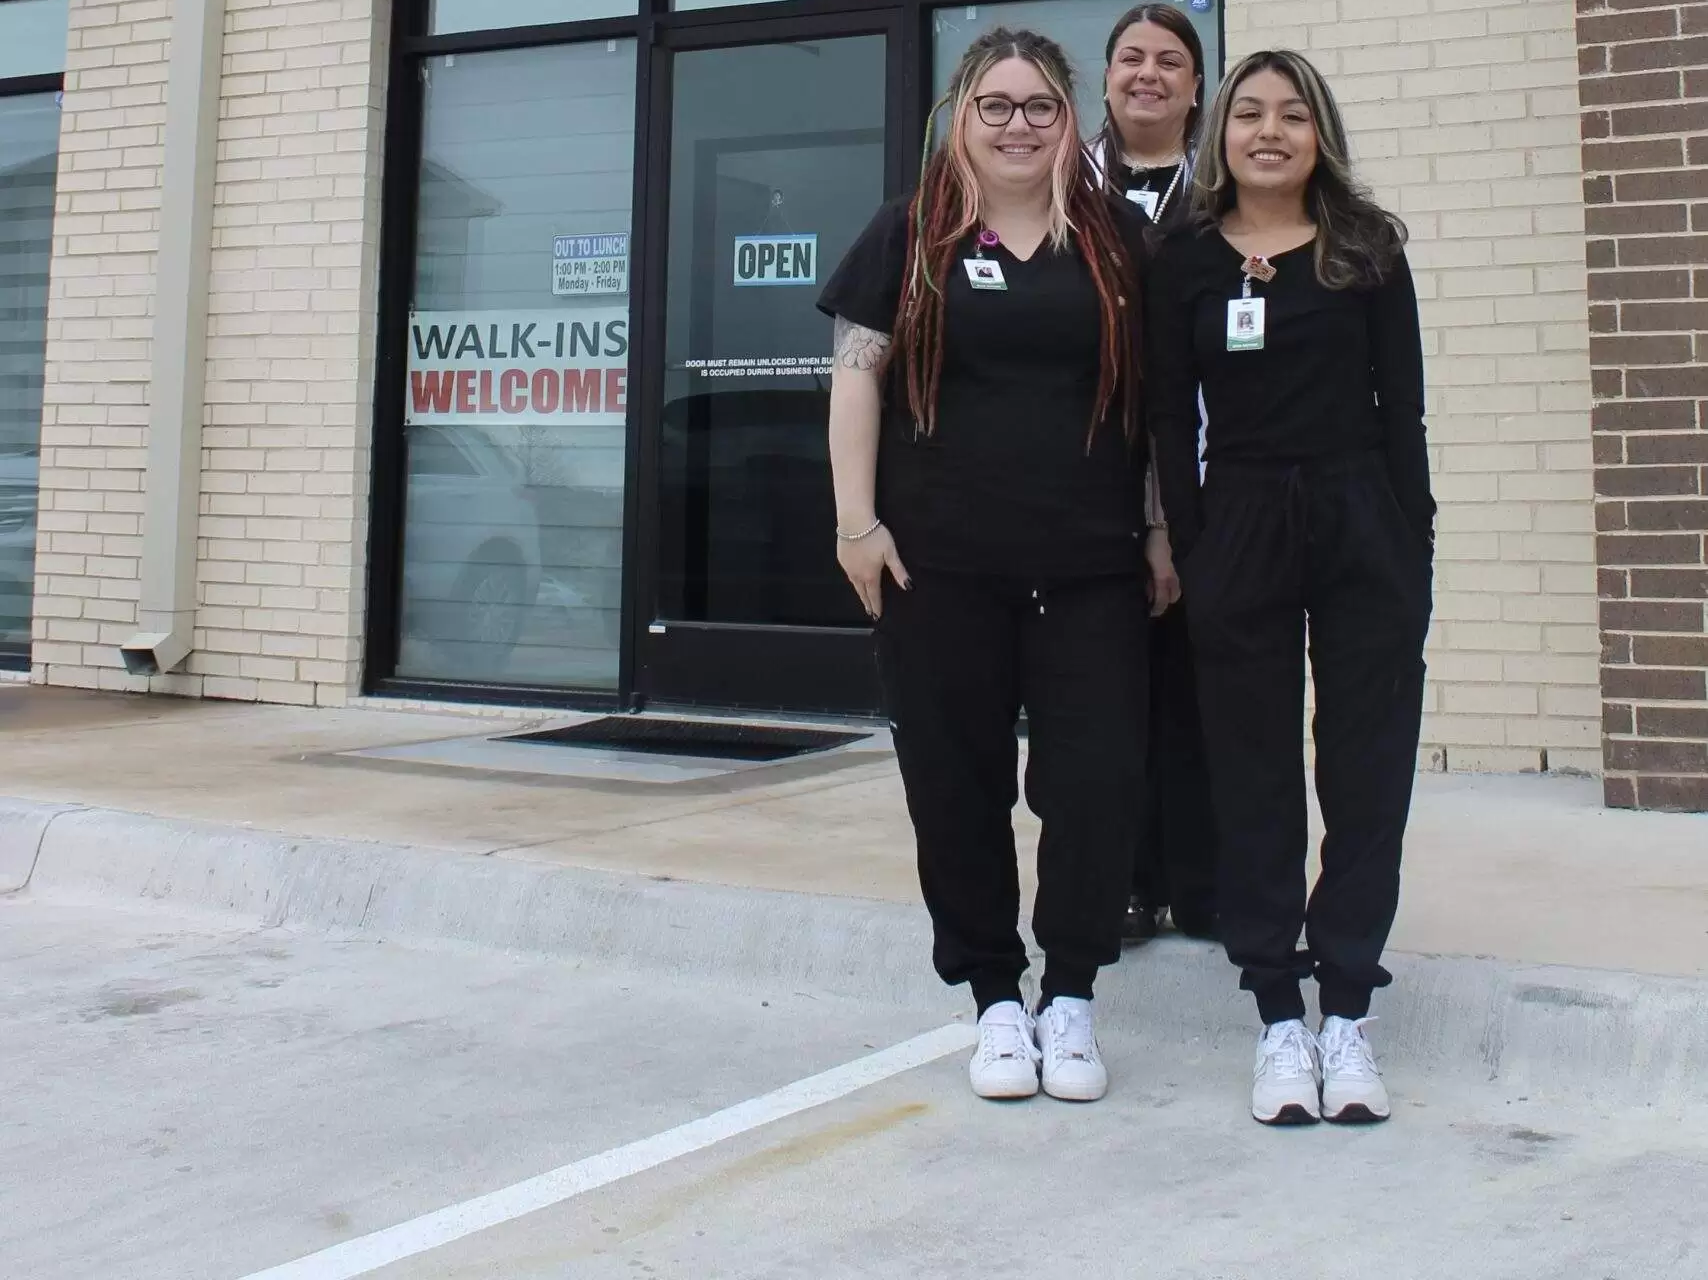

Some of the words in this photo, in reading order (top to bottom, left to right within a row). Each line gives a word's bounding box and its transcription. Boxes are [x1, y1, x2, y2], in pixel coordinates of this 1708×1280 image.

[555, 239, 575, 257] OUT
[577, 238, 591, 256] TO
[593, 236, 627, 255] LUNCH
[555, 262, 572, 275] 1:00
[574, 261, 587, 275] PM
[593, 260, 611, 274] 2:00
[613, 260, 626, 273] PM
[738, 242, 812, 280] OPEN
[558, 277, 589, 292] Monday
[596, 275, 622, 290] Friday
[412, 320, 628, 360] WALK-INS
[685, 359, 706, 368] DOOR
[707, 359, 726, 367] MUST
[728, 358, 756, 367] REMAIN
[757, 358, 796, 367] UNLOCKED
[798, 357, 820, 365] WHEN
[700, 369, 708, 377] IS
[709, 369, 746, 377] OCCUPIED
[746, 368, 774, 376] DURING
[775, 367, 812, 375] BUSINESS
[813, 366, 833, 374] HOUR
[411, 367, 627, 414] WELCOME
